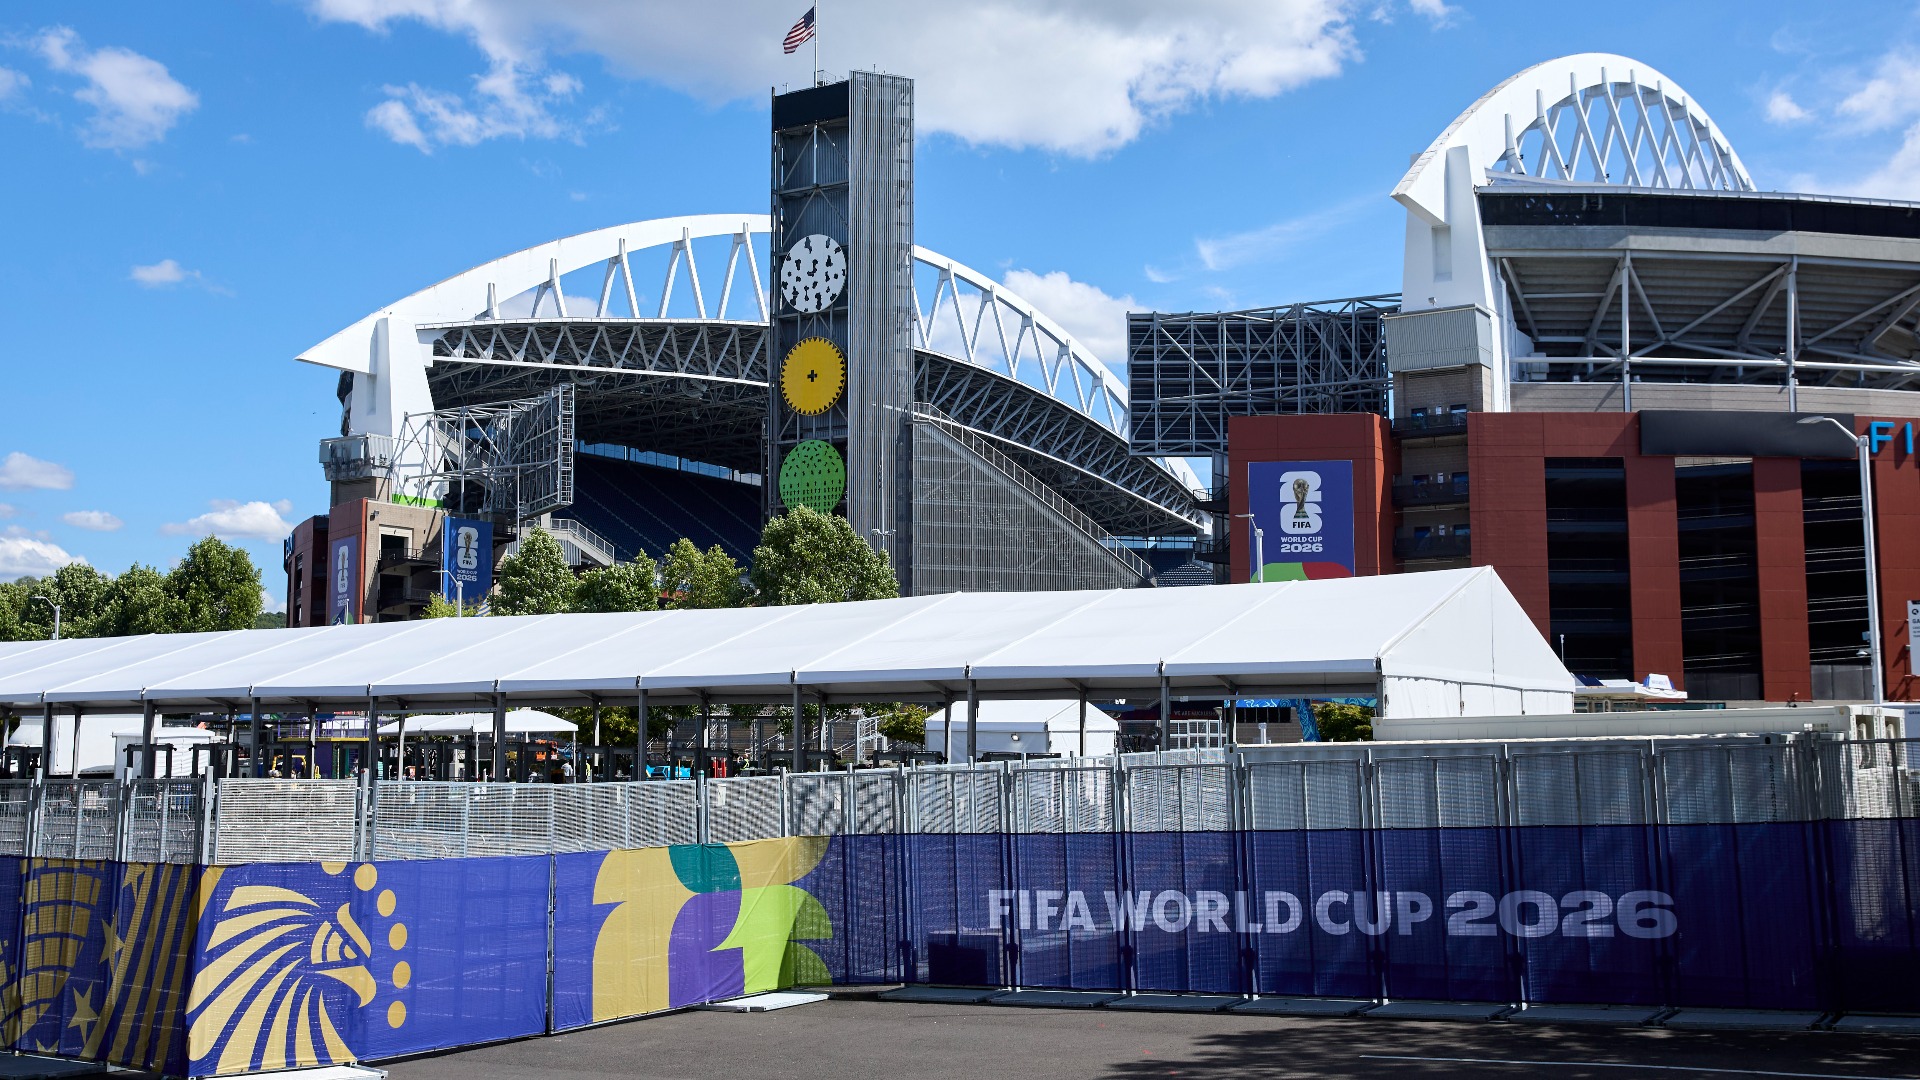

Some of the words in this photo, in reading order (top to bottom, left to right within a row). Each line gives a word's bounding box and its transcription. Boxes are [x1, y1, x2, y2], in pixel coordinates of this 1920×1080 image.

[1870, 421, 1914, 455] FI
[1281, 543, 1323, 552] 2026
[988, 889, 1096, 932] FIFA
[1103, 889, 1303, 934] WORLD
[1315, 889, 1433, 936] CUP
[1446, 889, 1678, 939] 2026
